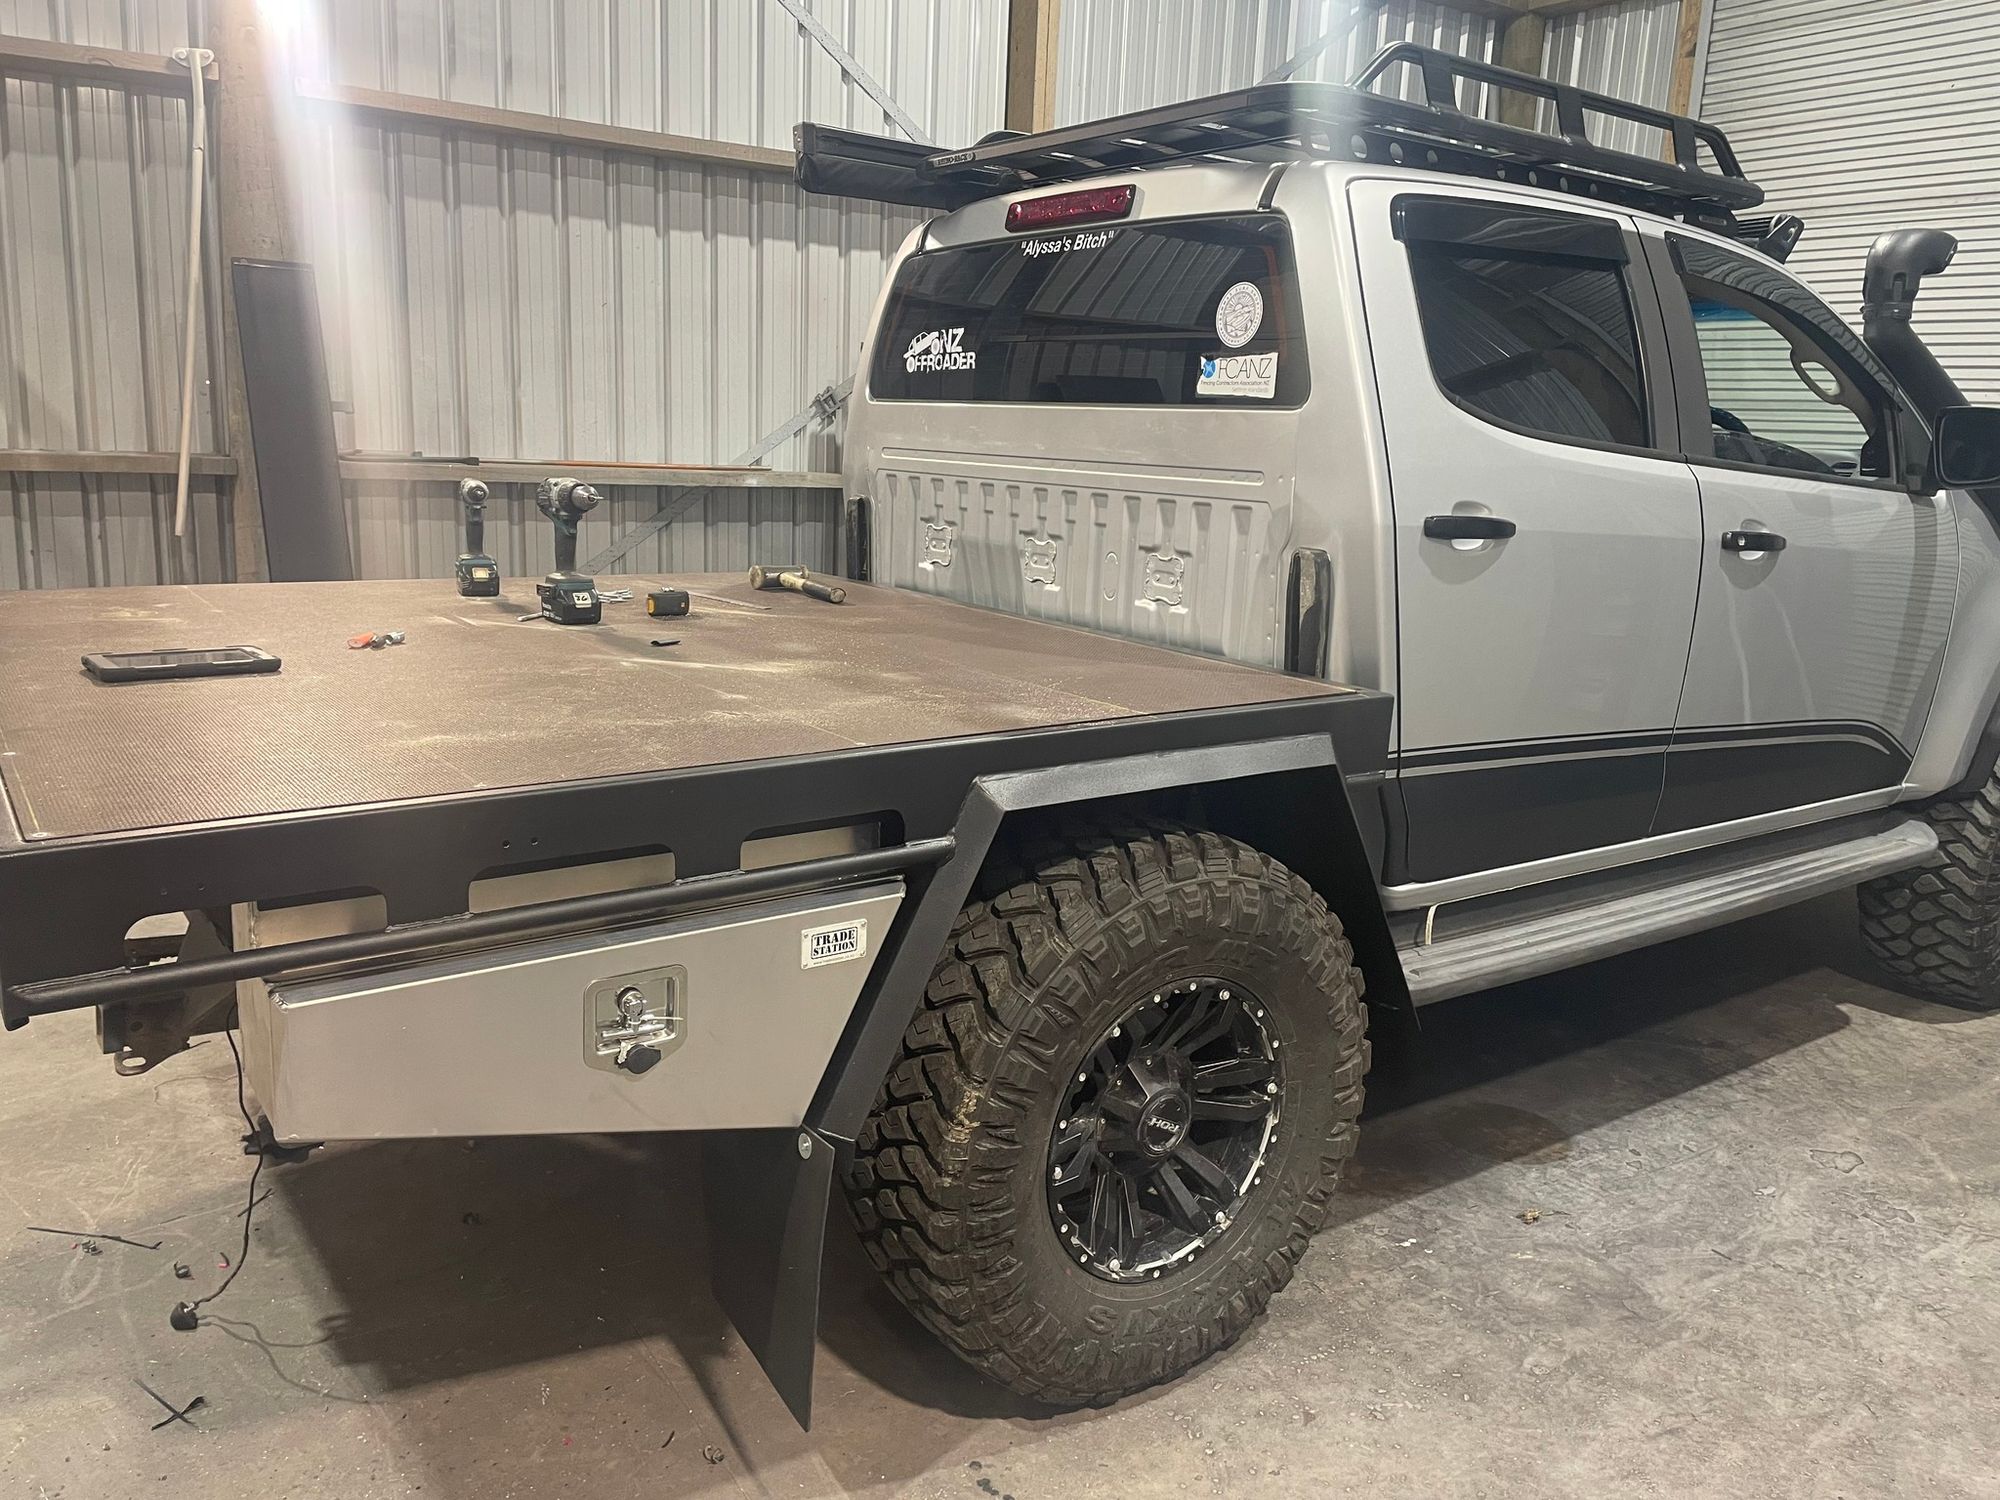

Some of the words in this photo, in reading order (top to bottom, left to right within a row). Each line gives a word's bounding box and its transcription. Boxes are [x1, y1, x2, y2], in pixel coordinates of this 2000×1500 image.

[1021, 236, 1072, 258] "Alyssa's
[1073, 230, 1115, 251] Bitch"
[940, 327, 965, 353] NZ
[1218, 357, 1273, 379] FCANZ
[814, 929, 856, 946] TRADE
[813, 940, 855, 956] STATION
[1148, 1117, 1180, 1133] ROH
